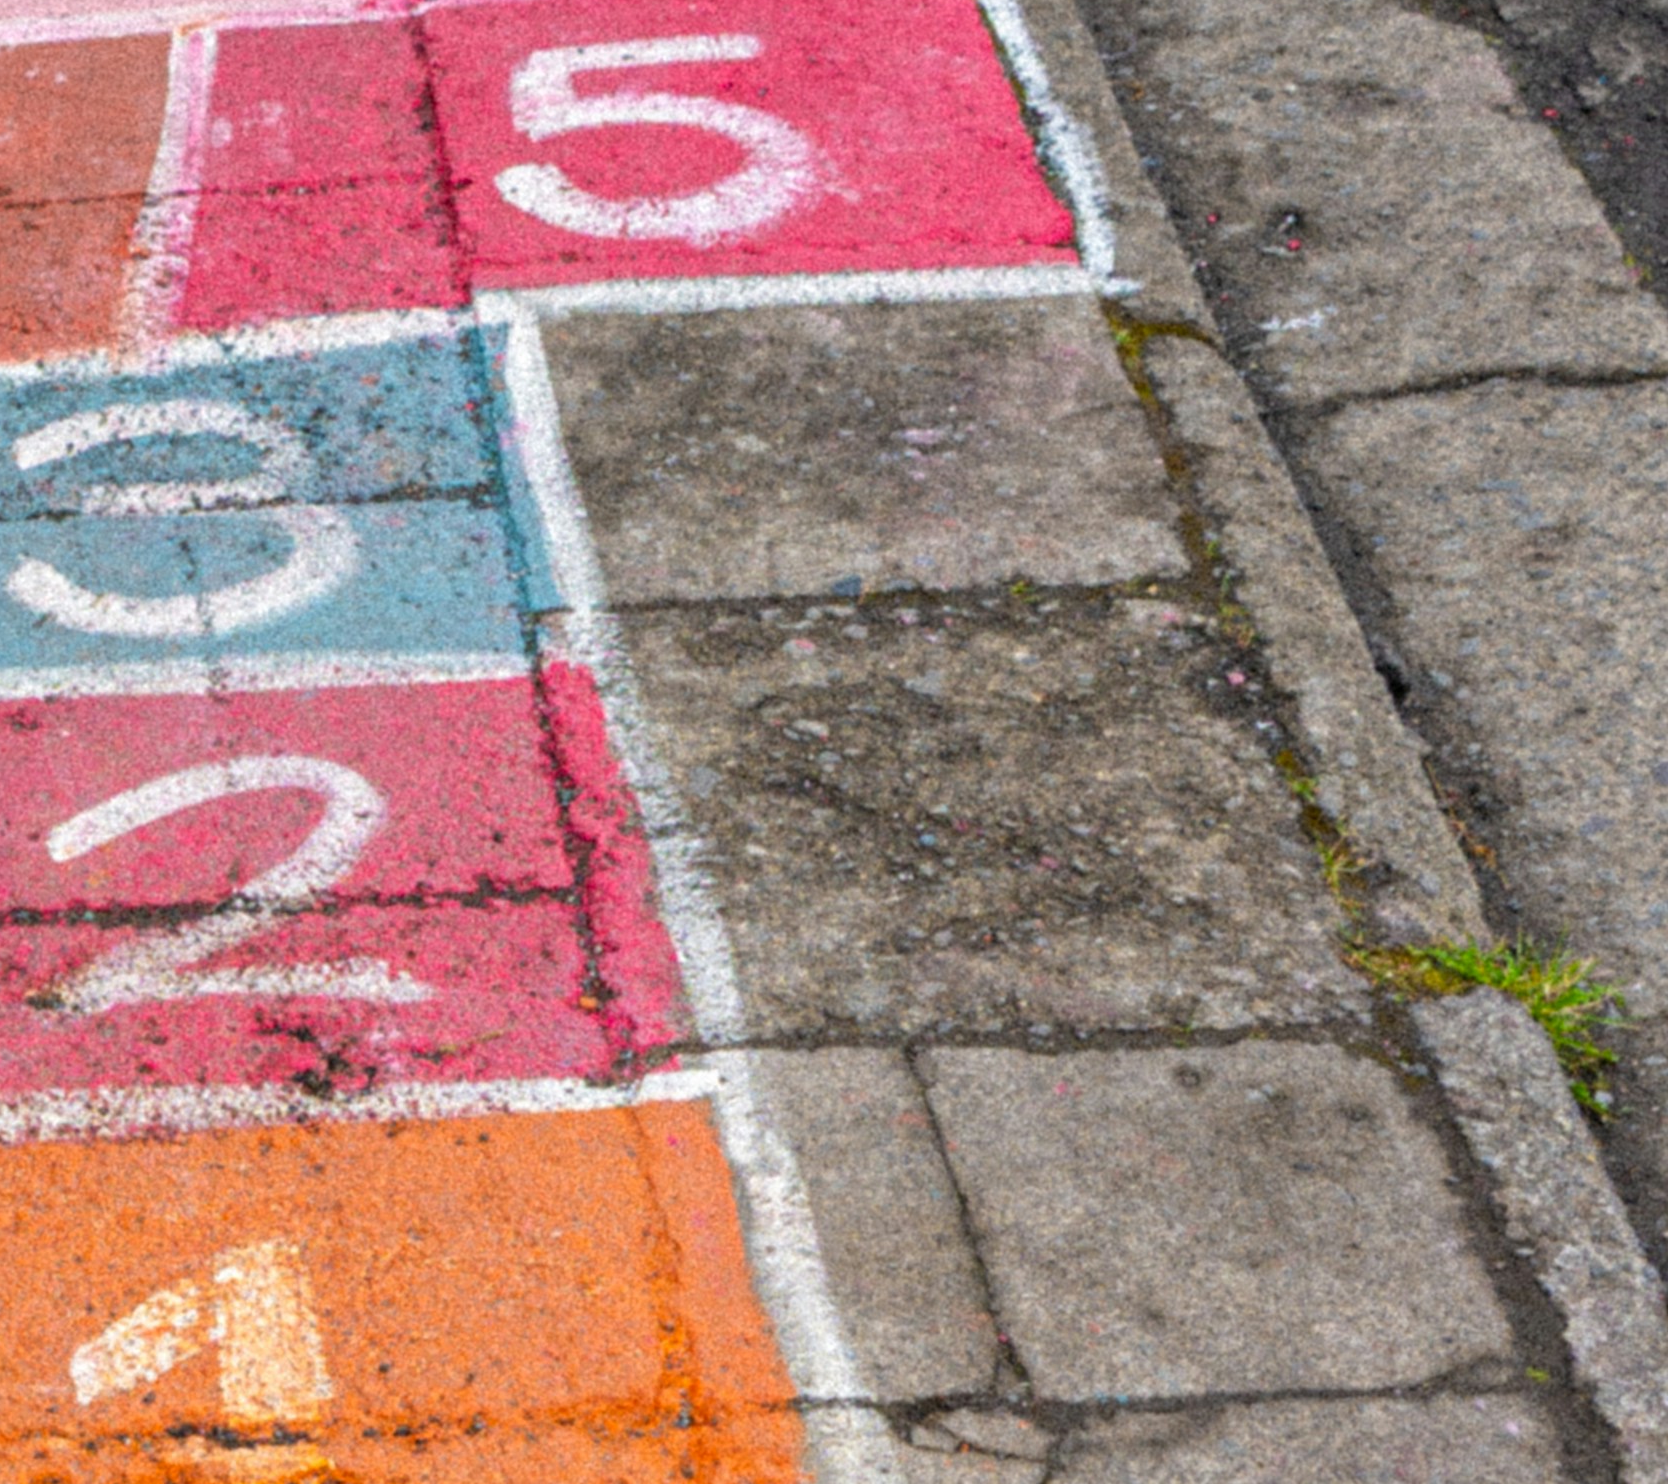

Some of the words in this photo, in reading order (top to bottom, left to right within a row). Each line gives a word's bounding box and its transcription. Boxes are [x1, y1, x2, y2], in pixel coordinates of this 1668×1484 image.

[493, 33, 817, 244] 5
[5, 400, 358, 638] 3
[46, 754, 433, 1015] 2
